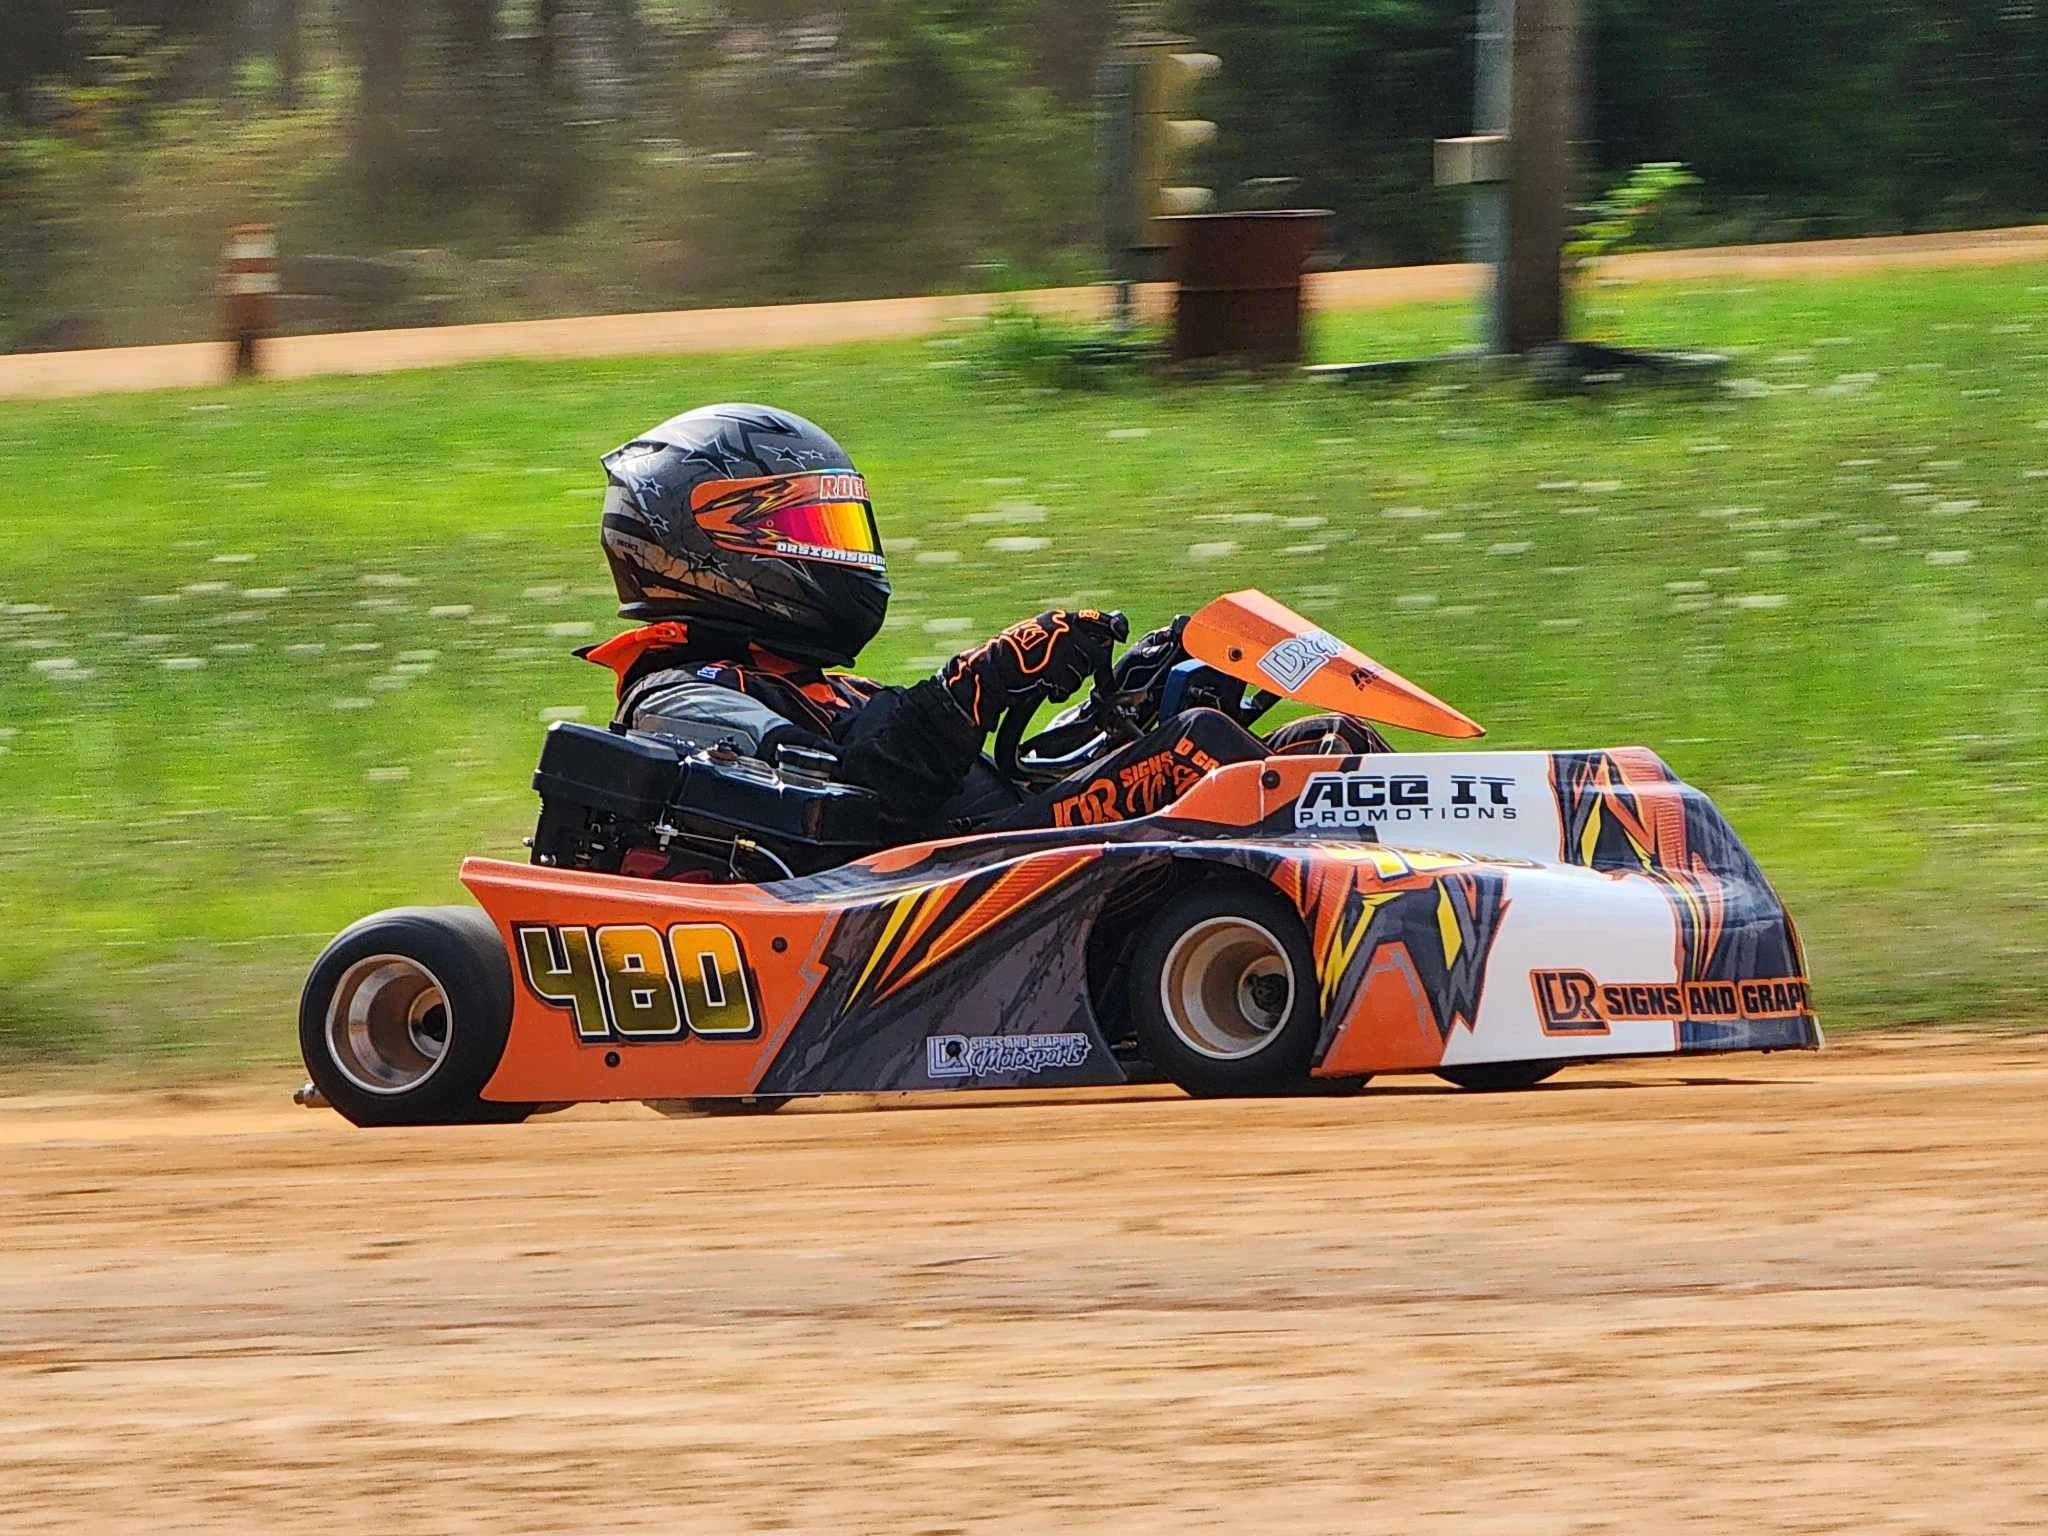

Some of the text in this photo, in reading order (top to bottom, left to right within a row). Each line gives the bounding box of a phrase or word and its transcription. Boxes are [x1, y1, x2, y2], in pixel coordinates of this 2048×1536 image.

[1300, 807, 1517, 823] PROMOTIONS
[513, 921, 764, 1042] 480
[1602, 985, 1683, 1016] SIGNS
[1690, 982, 1738, 1015] AND
[970, 1038, 1004, 1050] SIGNS
[1004, 1037, 1029, 1049] AND
[972, 1044, 1083, 1073] Motorsports
